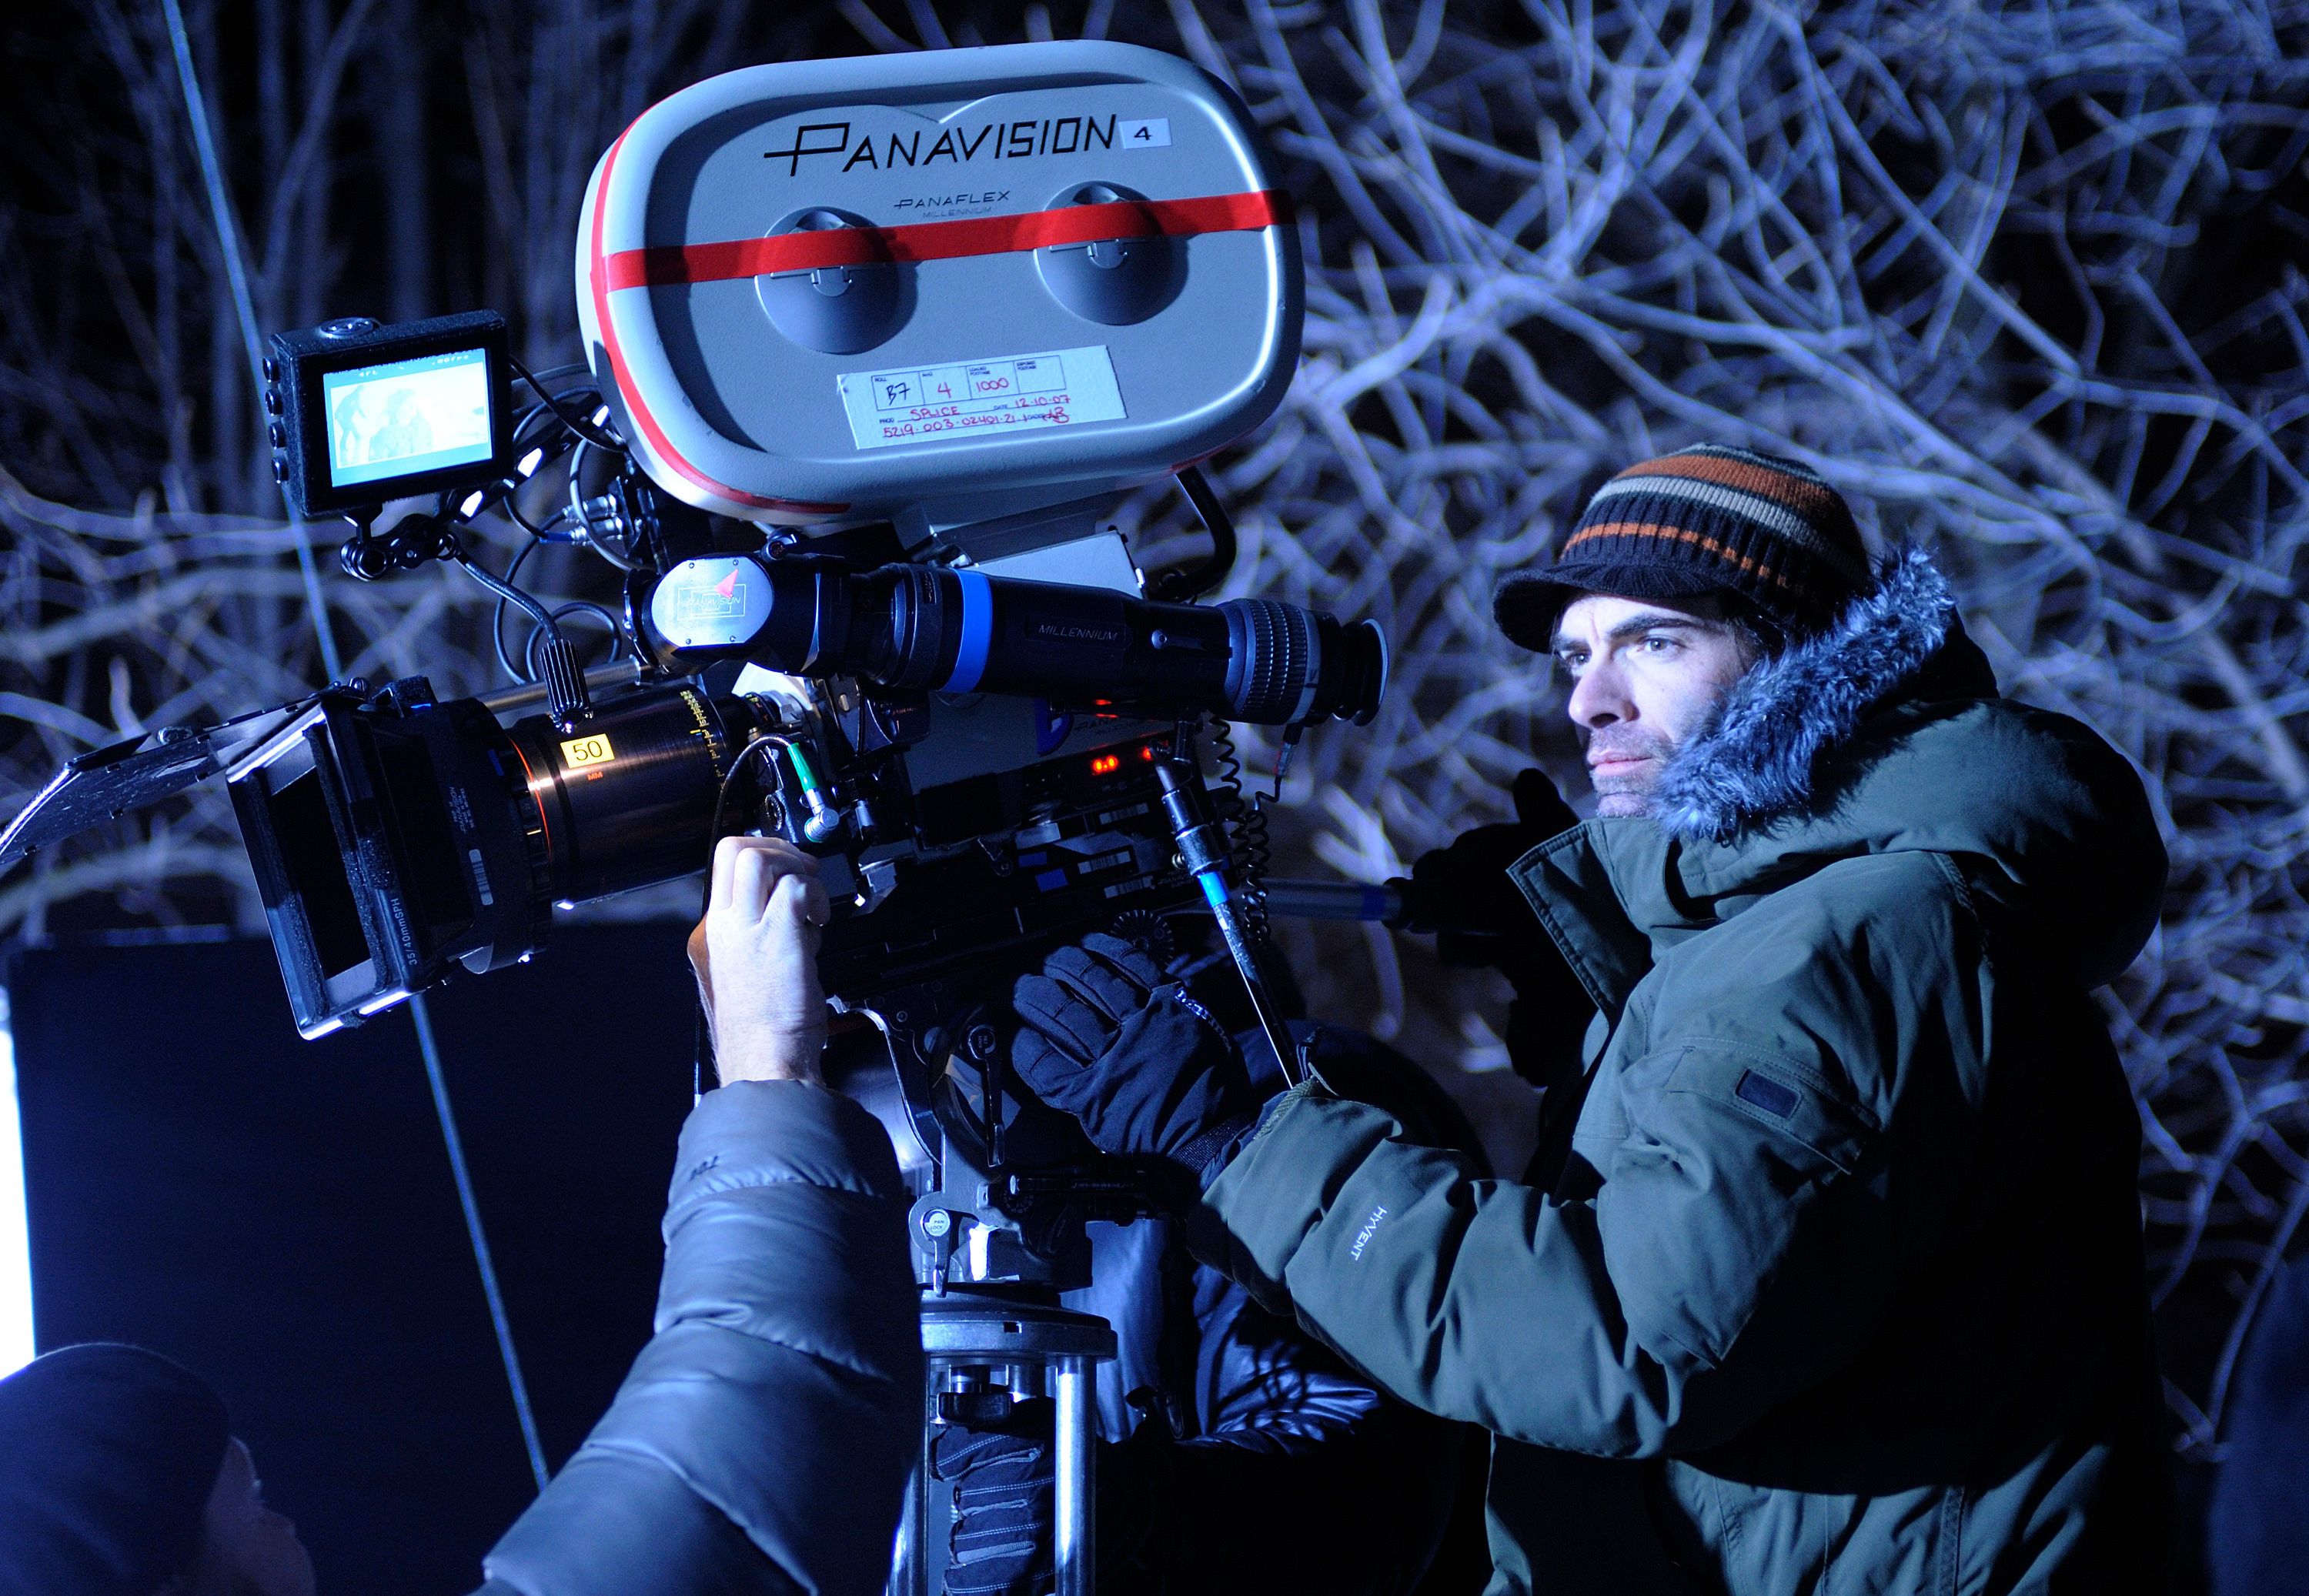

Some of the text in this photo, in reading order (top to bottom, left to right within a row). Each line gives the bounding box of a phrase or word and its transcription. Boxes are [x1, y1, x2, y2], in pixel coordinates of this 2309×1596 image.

[1134, 126, 1152, 140] 4
[764, 115, 1116, 176] PANAVISION
[894, 191, 1011, 209] PANAFLEX
[924, 207, 991, 218] MILLENNIUM
[937, 382, 952, 399] 4
[976, 378, 1009, 392] 1000
[911, 406, 960, 421] SPLICE
[1038, 625, 1118, 641] MILLENNIUM
[573, 740, 603, 761] 50
[1351, 1206, 1387, 1260] HYVENT
